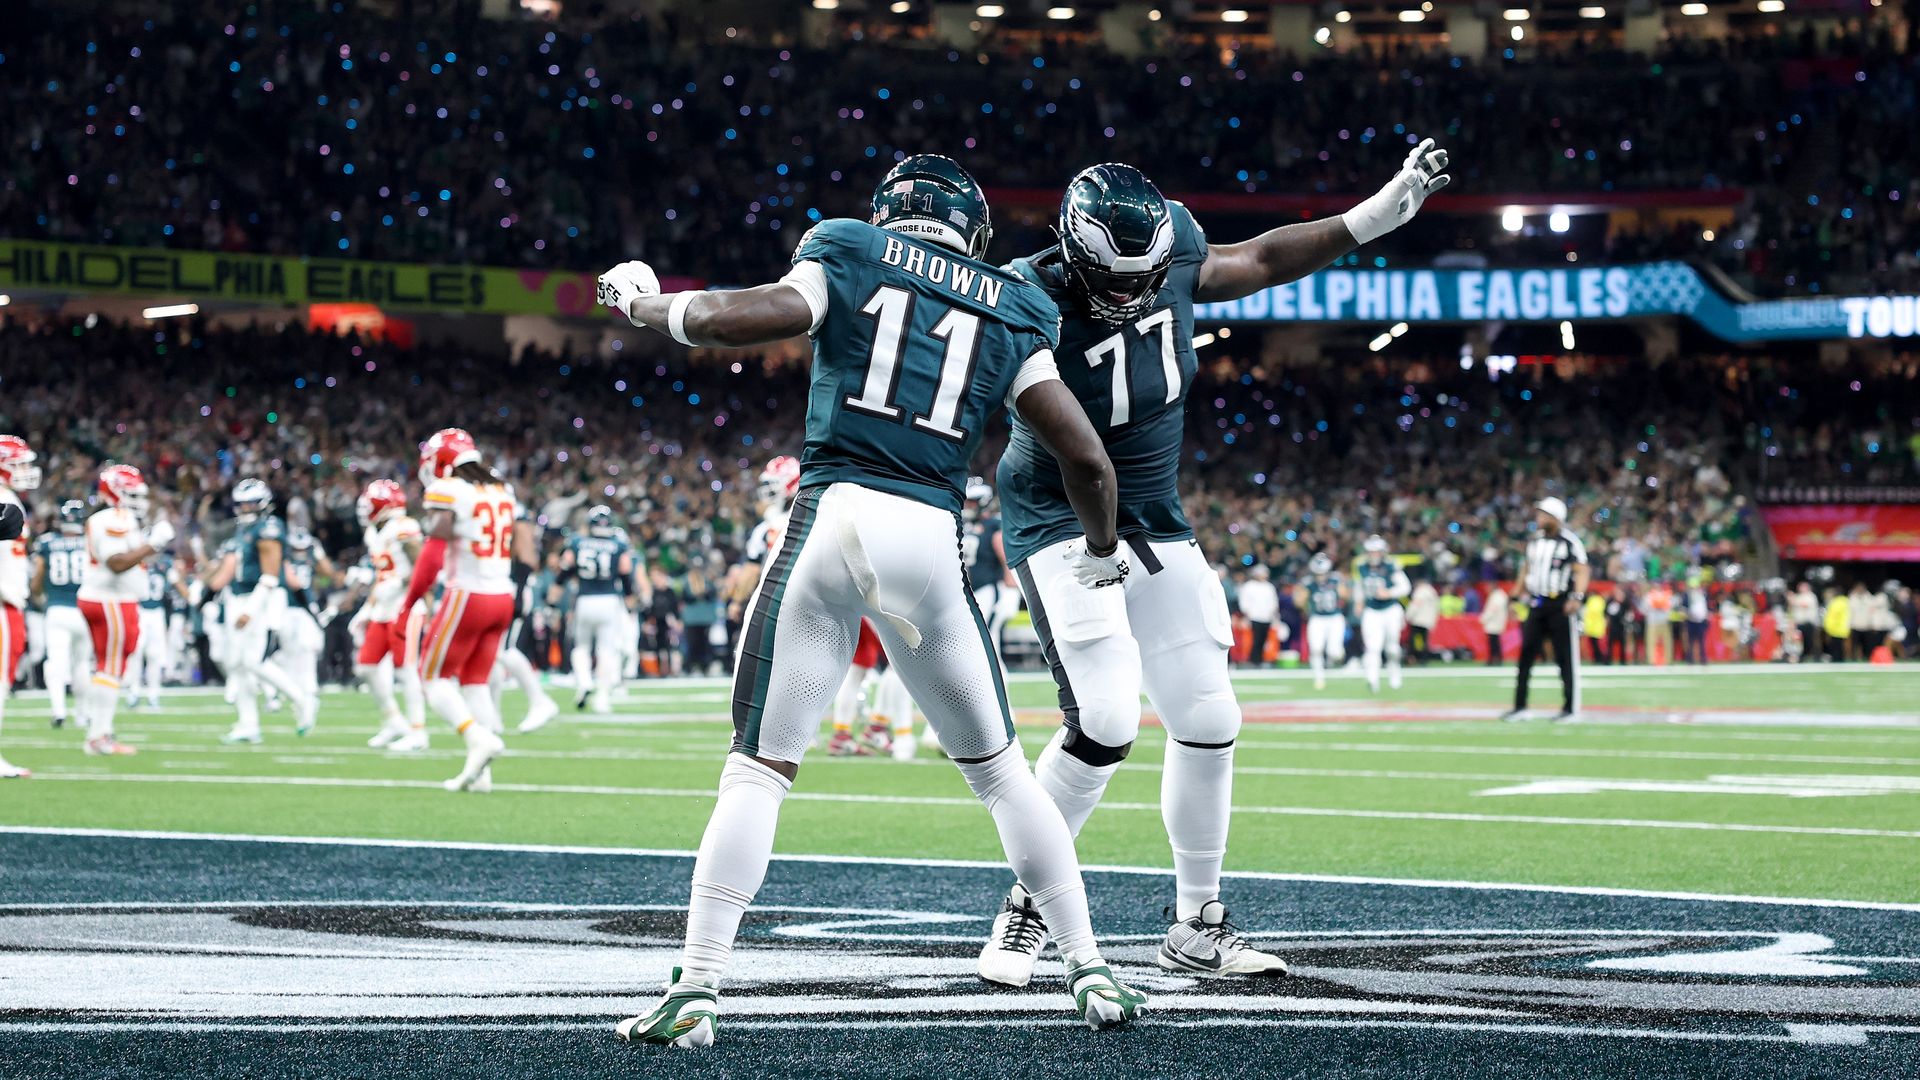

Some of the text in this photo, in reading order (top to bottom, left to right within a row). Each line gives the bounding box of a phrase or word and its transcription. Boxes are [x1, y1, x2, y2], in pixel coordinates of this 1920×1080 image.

[900, 192, 934, 213] 11
[921, 225, 945, 236] LOVE
[306, 265, 485, 306] EAGLES
[880, 235, 1004, 309] BROWN
[1457, 266, 1630, 320] EAGLES
[1839, 296, 1920, 338] TOU
[842, 282, 983, 444] 11
[1083, 307, 1182, 427] 77
[471, 501, 514, 560] 32
[576, 549, 612, 580] 51
